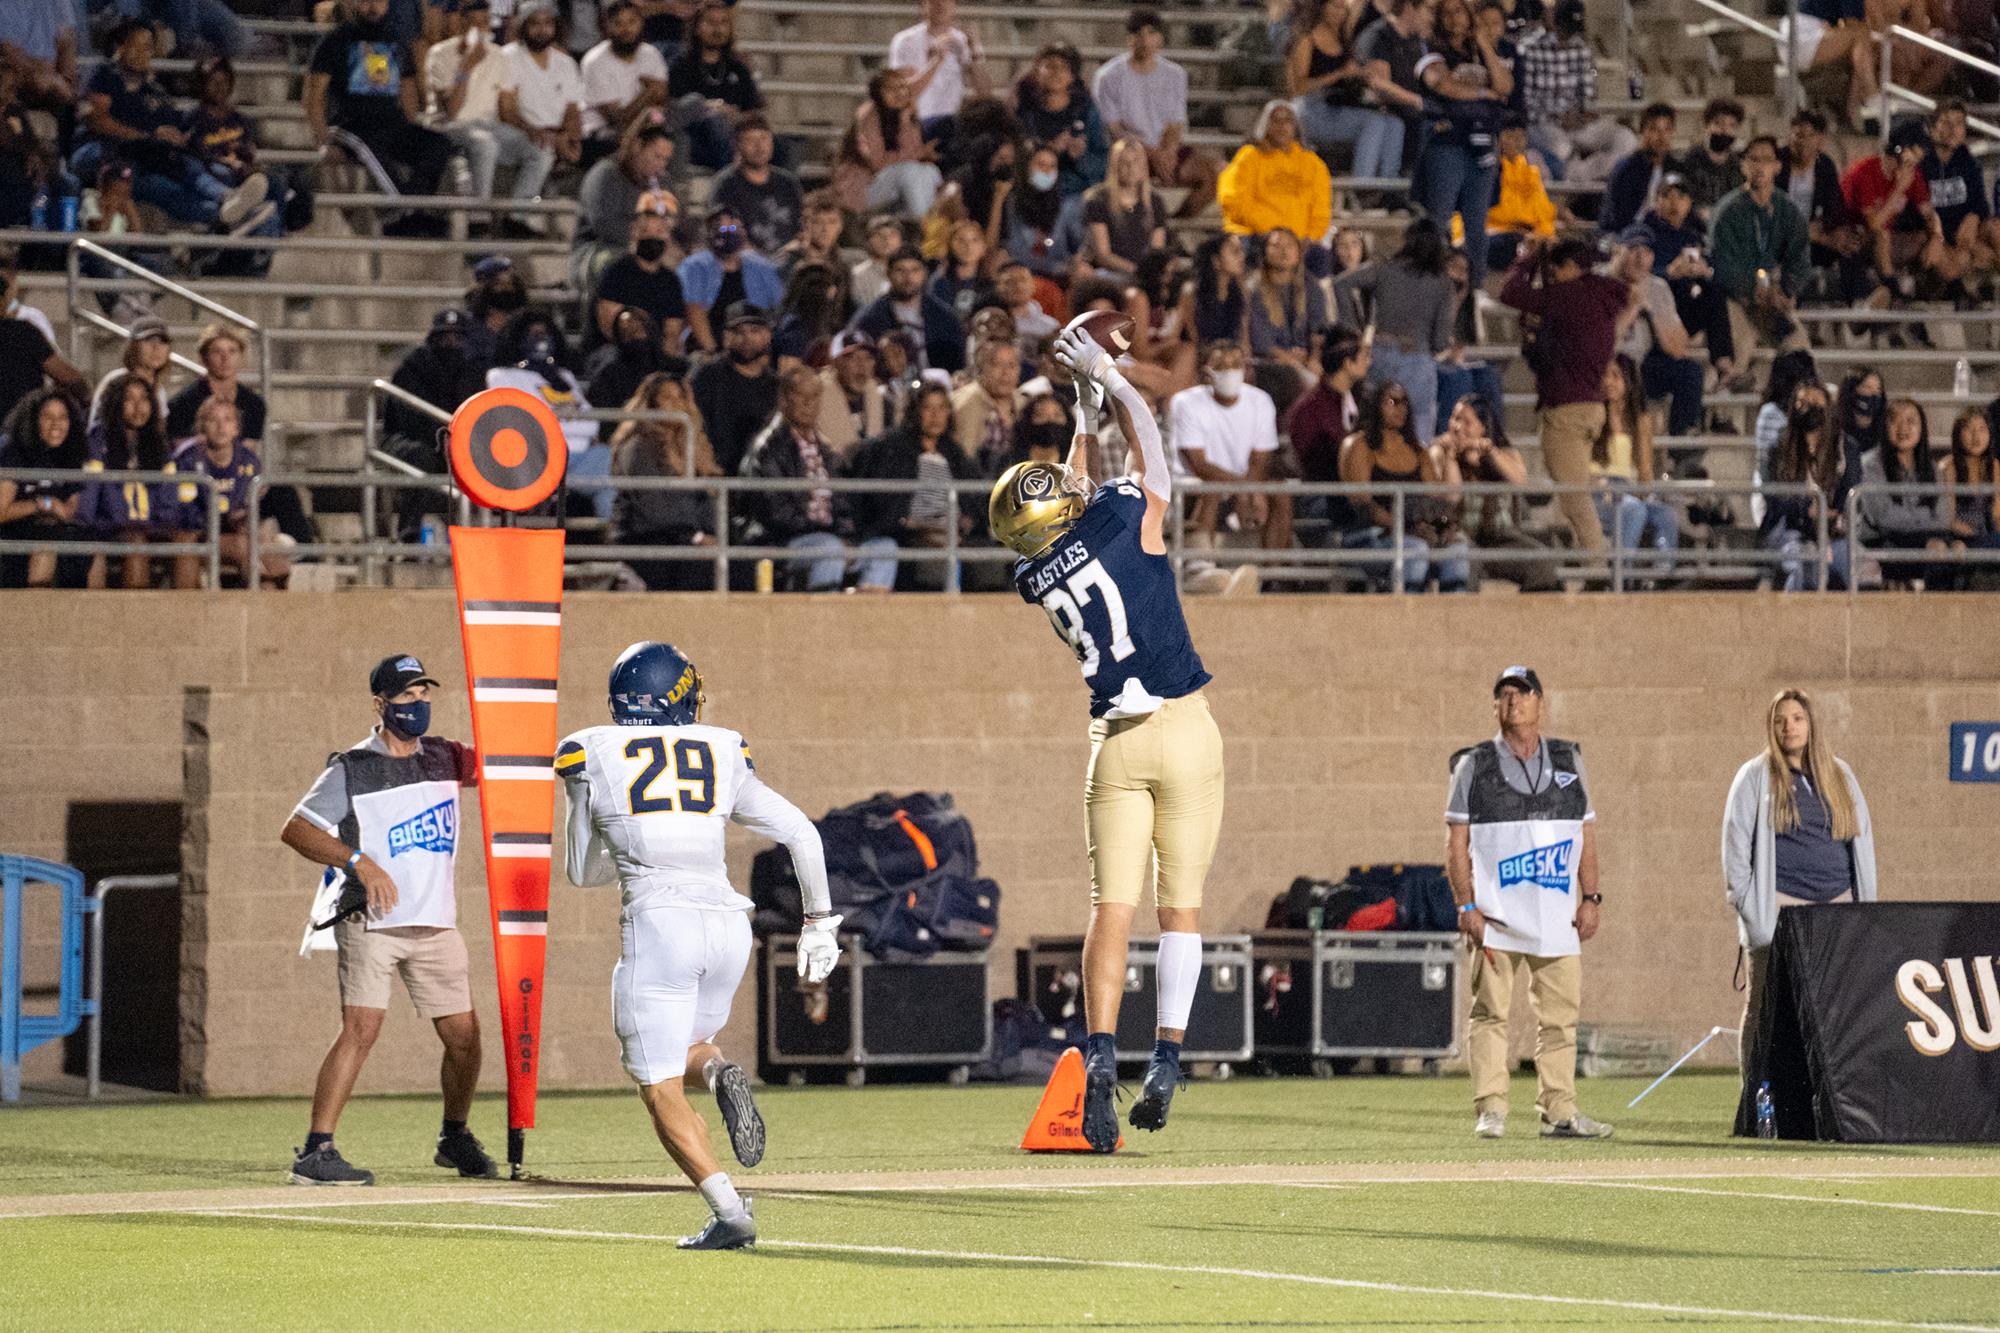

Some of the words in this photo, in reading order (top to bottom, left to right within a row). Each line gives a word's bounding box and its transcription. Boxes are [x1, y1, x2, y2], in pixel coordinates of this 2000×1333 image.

[1027, 540, 1089, 597] CASTLES
[1042, 557, 1136, 678] 87
[623, 735, 717, 817] 29
[1894, 955, 2000, 1057] SU
[1048, 1121, 1082, 1137] Gilma
